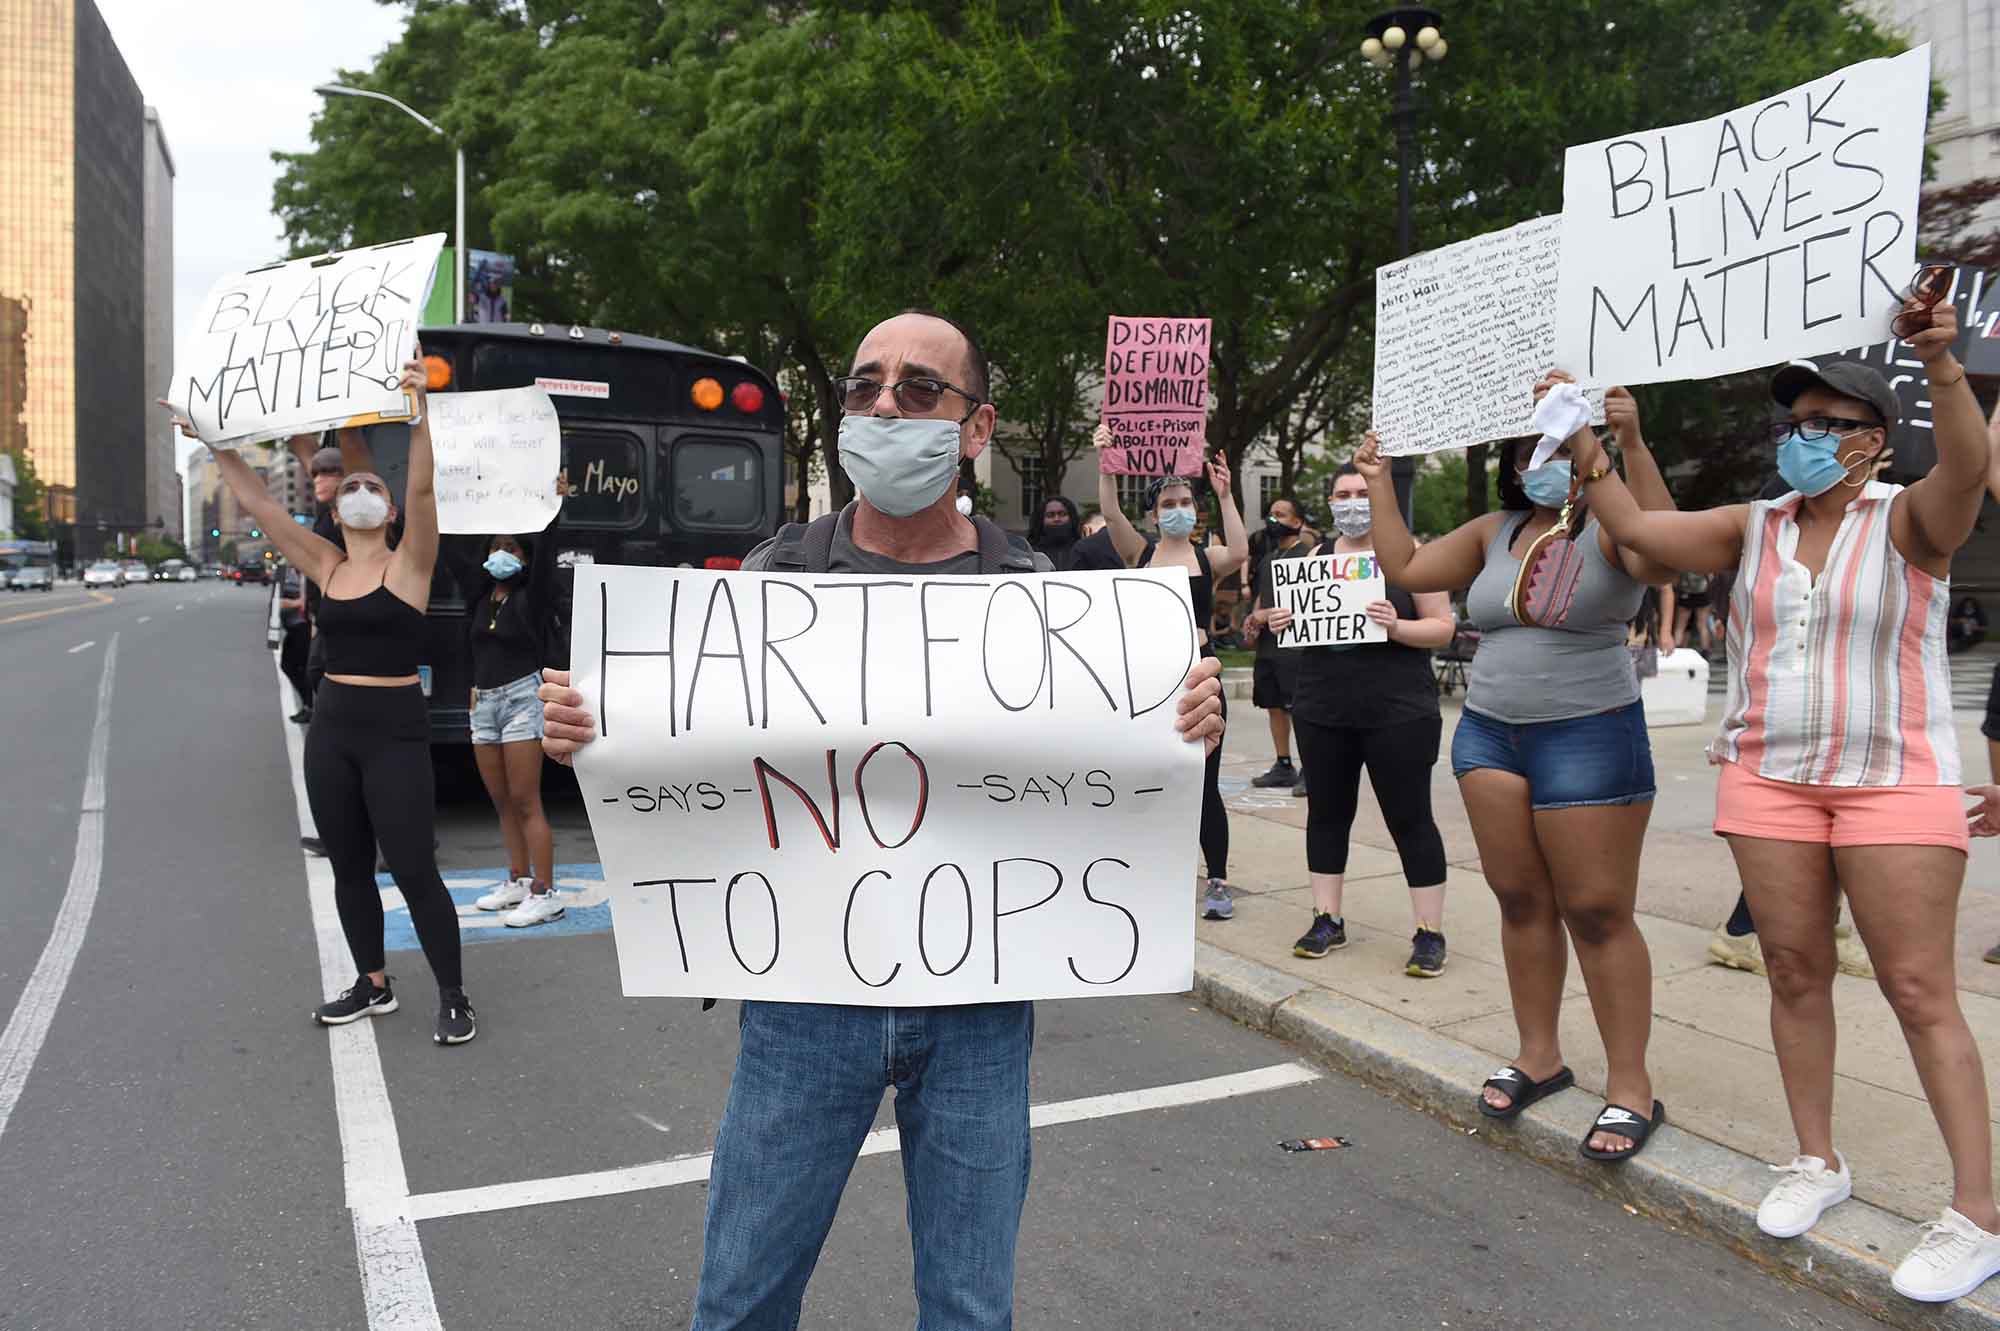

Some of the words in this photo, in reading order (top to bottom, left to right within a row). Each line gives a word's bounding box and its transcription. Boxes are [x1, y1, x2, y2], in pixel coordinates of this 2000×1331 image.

[1605, 79, 1846, 219] BLACK
[1669, 127, 1885, 269] LIVES
[207, 258, 416, 335] BLACK
[1412, 282, 1441, 299] Hall
[1589, 210, 1905, 377] MATTER
[223, 292, 388, 369] LIVES
[1113, 321, 1207, 346] DISARM
[1110, 350, 1206, 376] DEFUND
[1108, 377, 1207, 408] DISMANTLE
[1112, 434, 1190, 449] ABOLITION
[584, 459, 639, 502] Mayo
[1126, 449, 1178, 475] NOW
[1273, 560, 1331, 587] BLACK
[1332, 556, 1380, 582] LGBT
[1277, 583, 1342, 615] LIVES
[1280, 613, 1367, 645] MATTER
[601, 577, 1196, 738] HARTFORD
[752, 740, 930, 854] NO
[632, 870, 781, 976] TO
[842, 857, 1140, 989] COPS
